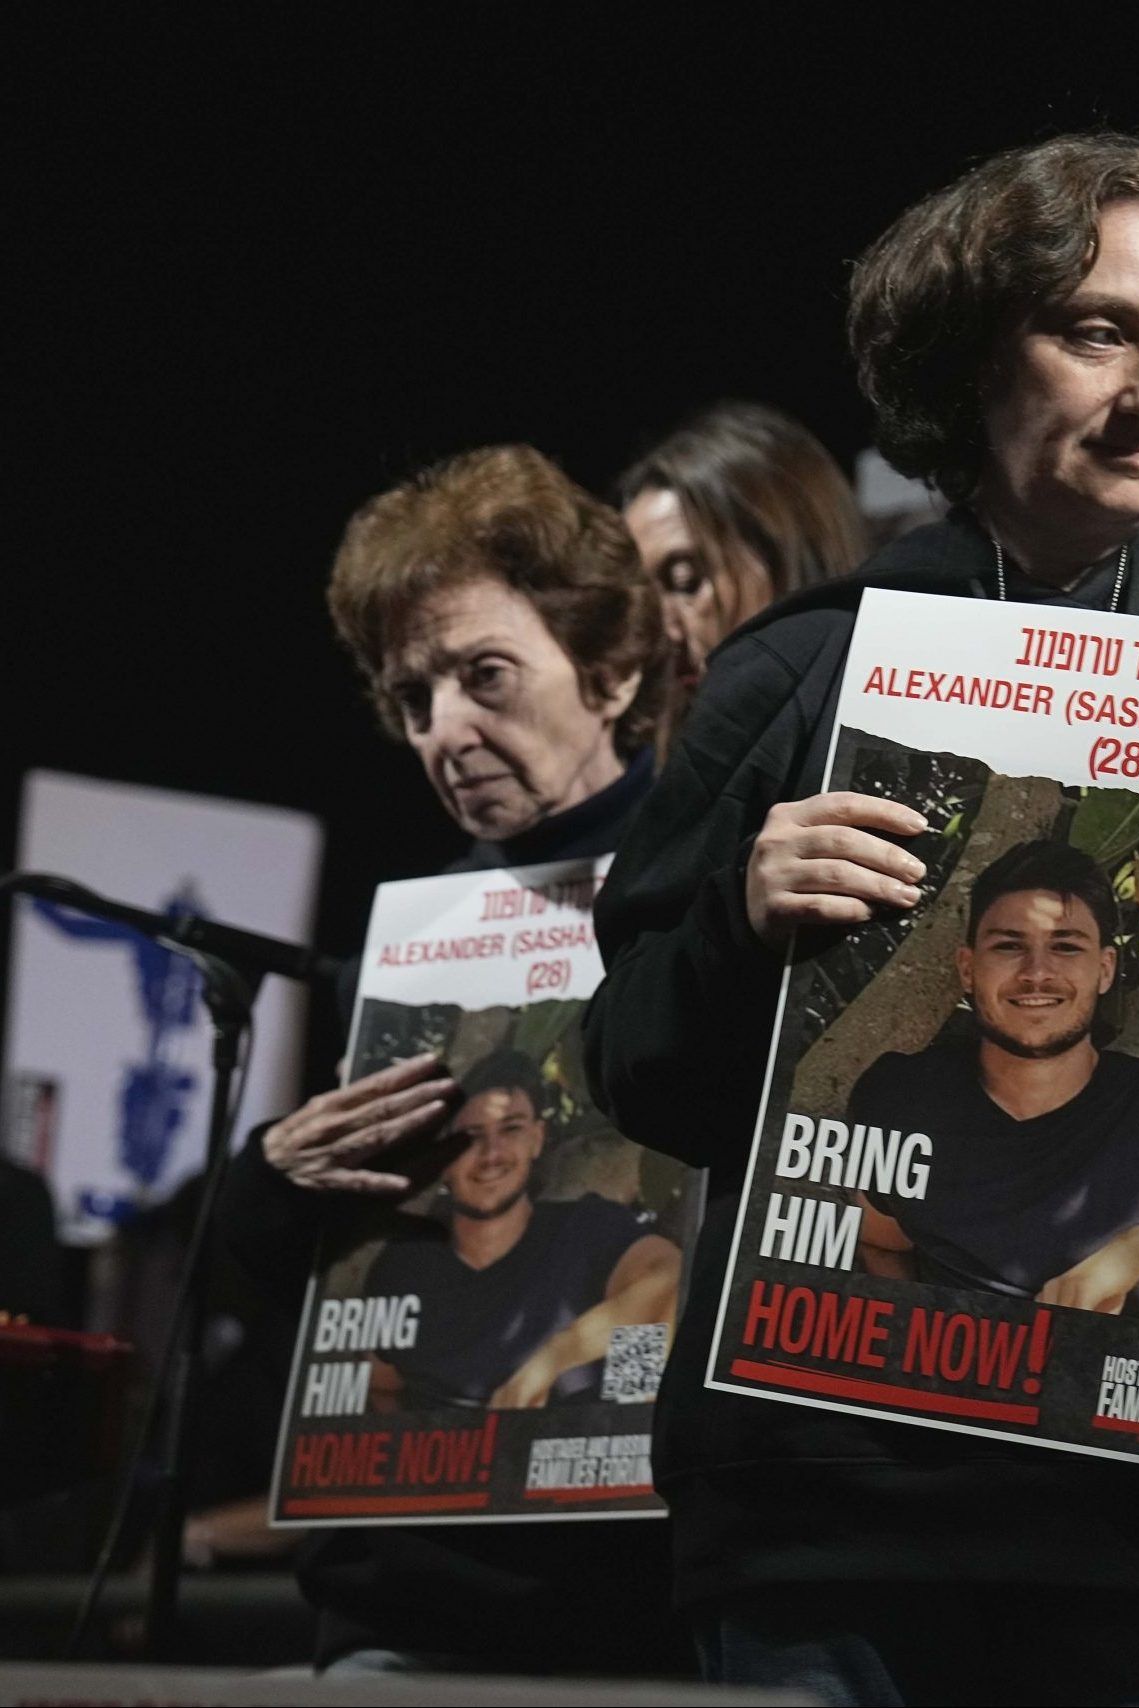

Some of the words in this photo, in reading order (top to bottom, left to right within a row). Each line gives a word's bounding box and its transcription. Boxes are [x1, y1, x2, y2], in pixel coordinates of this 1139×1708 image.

[1015, 627, 1124, 676] טרופנוב
[863, 666, 1054, 716] ALEXANDER
[377, 932, 505, 968] ALEXANDER
[526, 959, 572, 996] (28)
[775, 1113, 933, 1200] BRING
[759, 1192, 862, 1271] HIM
[313, 1294, 421, 1353] BRING
[742, 1280, 895, 1369] HOME
[902, 1307, 1053, 1396] NOW!
[302, 1361, 371, 1418] HIM
[291, 1433, 392, 1488] HOME
[396, 1411, 499, 1485] NOW!
[525, 1457, 599, 1490] FAMILIES
